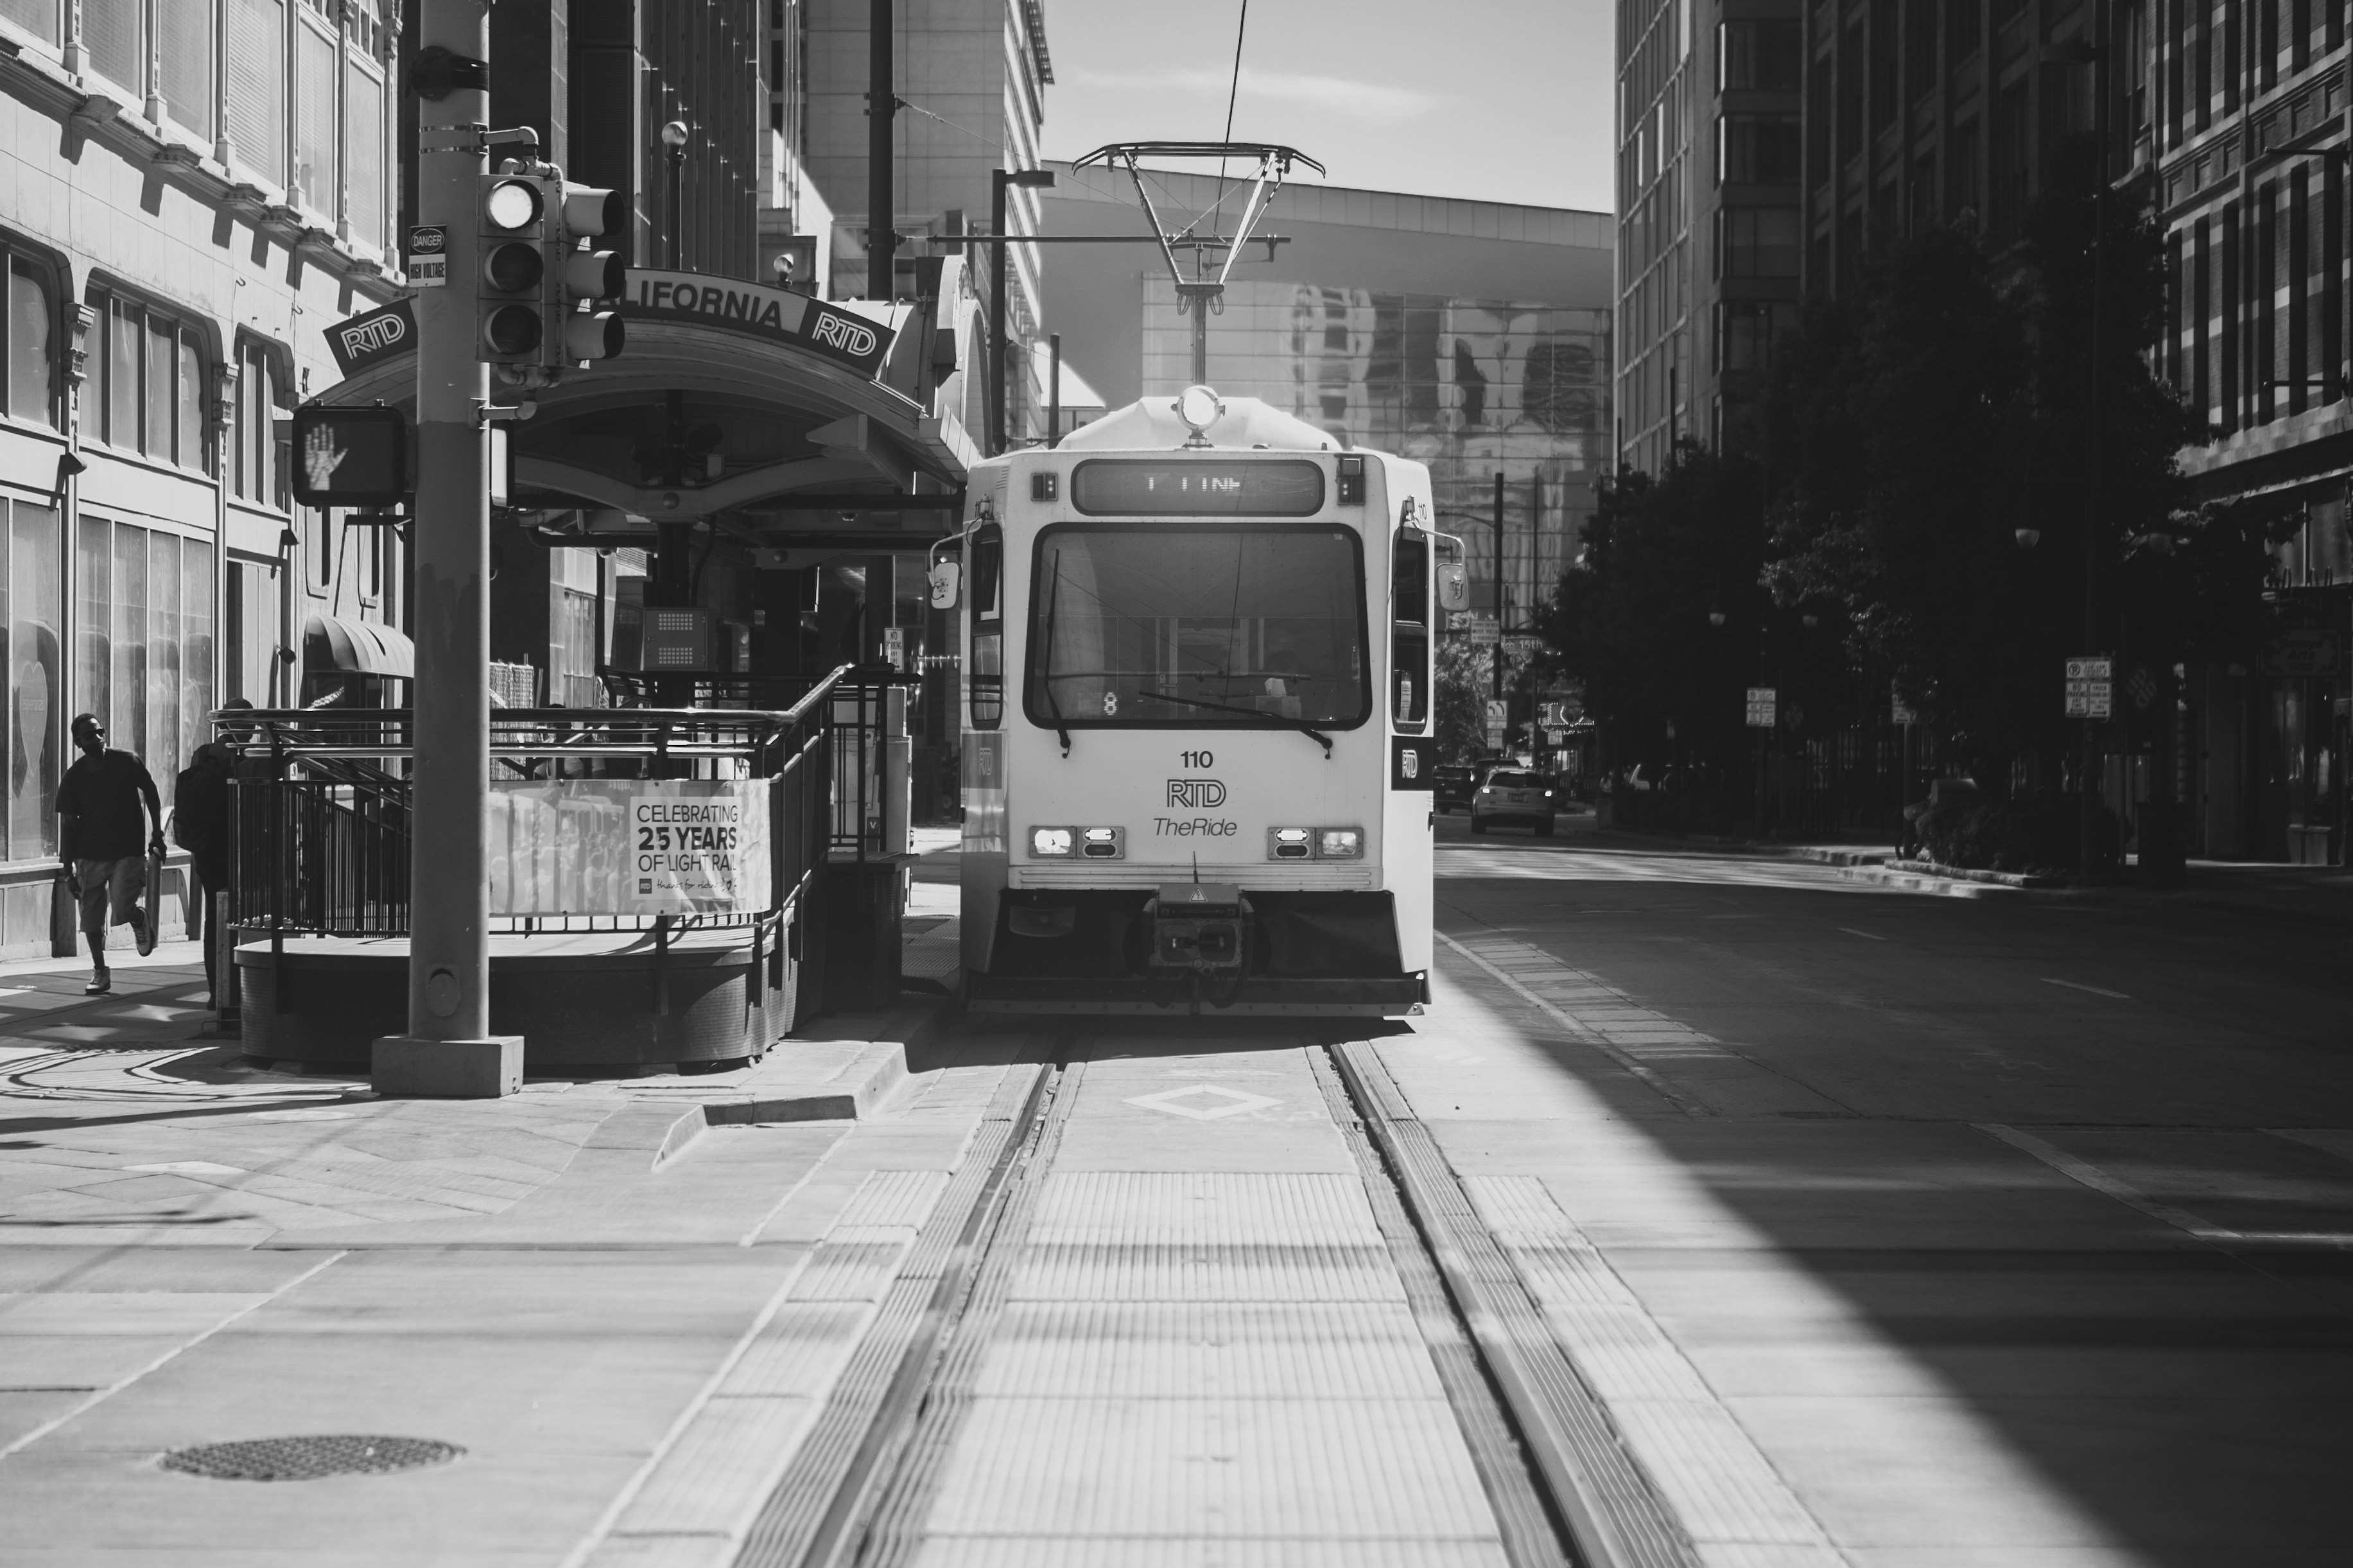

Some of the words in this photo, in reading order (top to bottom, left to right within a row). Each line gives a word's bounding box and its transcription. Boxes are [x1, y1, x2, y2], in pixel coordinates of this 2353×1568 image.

[413, 235, 442, 246] DANGER
[410, 264, 422, 279] HIGH
[423, 262, 445, 279] VOLTAGE
[340, 313, 405, 359] RTD
[812, 311, 877, 357] RTD
[890, 632, 898, 641] NO
[1519, 639, 1542, 650] 15th
[1104, 692, 1117, 716] 8
[1180, 750, 1213, 768] 110
[1402, 749, 1418, 779] RTD
[1167, 779, 1226, 807] RTD
[637, 805, 738, 823] CELEBRATING
[1154, 818, 1237, 836] TheRide
[638, 827, 670, 850] 25
[675, 827, 737, 850] YEARS
[638, 854, 664, 872] OF
[668, 854, 709, 872] LIGHT
[712, 854, 736, 872] RAIL
[684, 879, 695, 892] for
